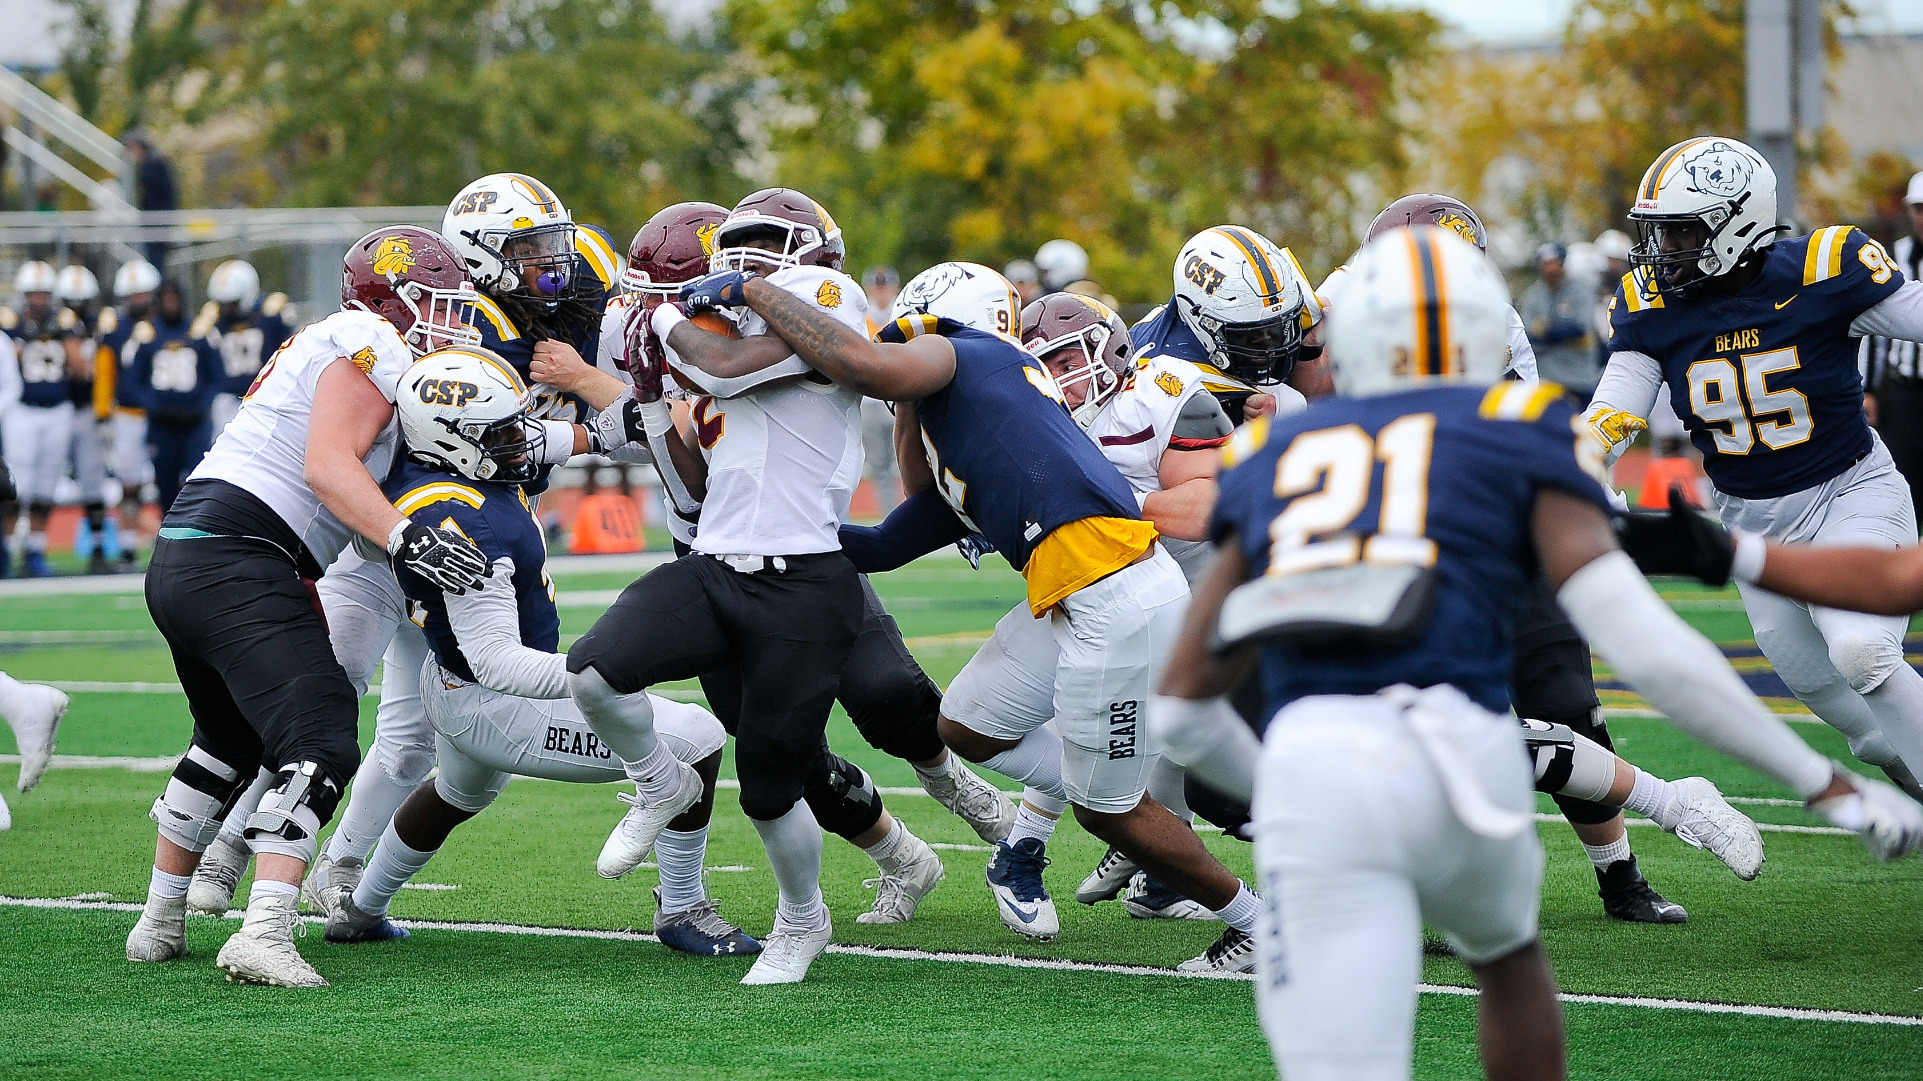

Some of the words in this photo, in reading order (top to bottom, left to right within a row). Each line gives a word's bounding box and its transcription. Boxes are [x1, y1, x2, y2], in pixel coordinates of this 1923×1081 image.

[452, 191, 498, 216] CSP
[996, 309, 1009, 333] 9
[1714, 328, 1760, 352] BEARS
[419, 378, 479, 408] CSP
[1686, 345, 1815, 455] 95
[1266, 412, 1439, 578] 21
[544, 726, 612, 759] BEARS
[1108, 700, 1138, 760] BEARS
